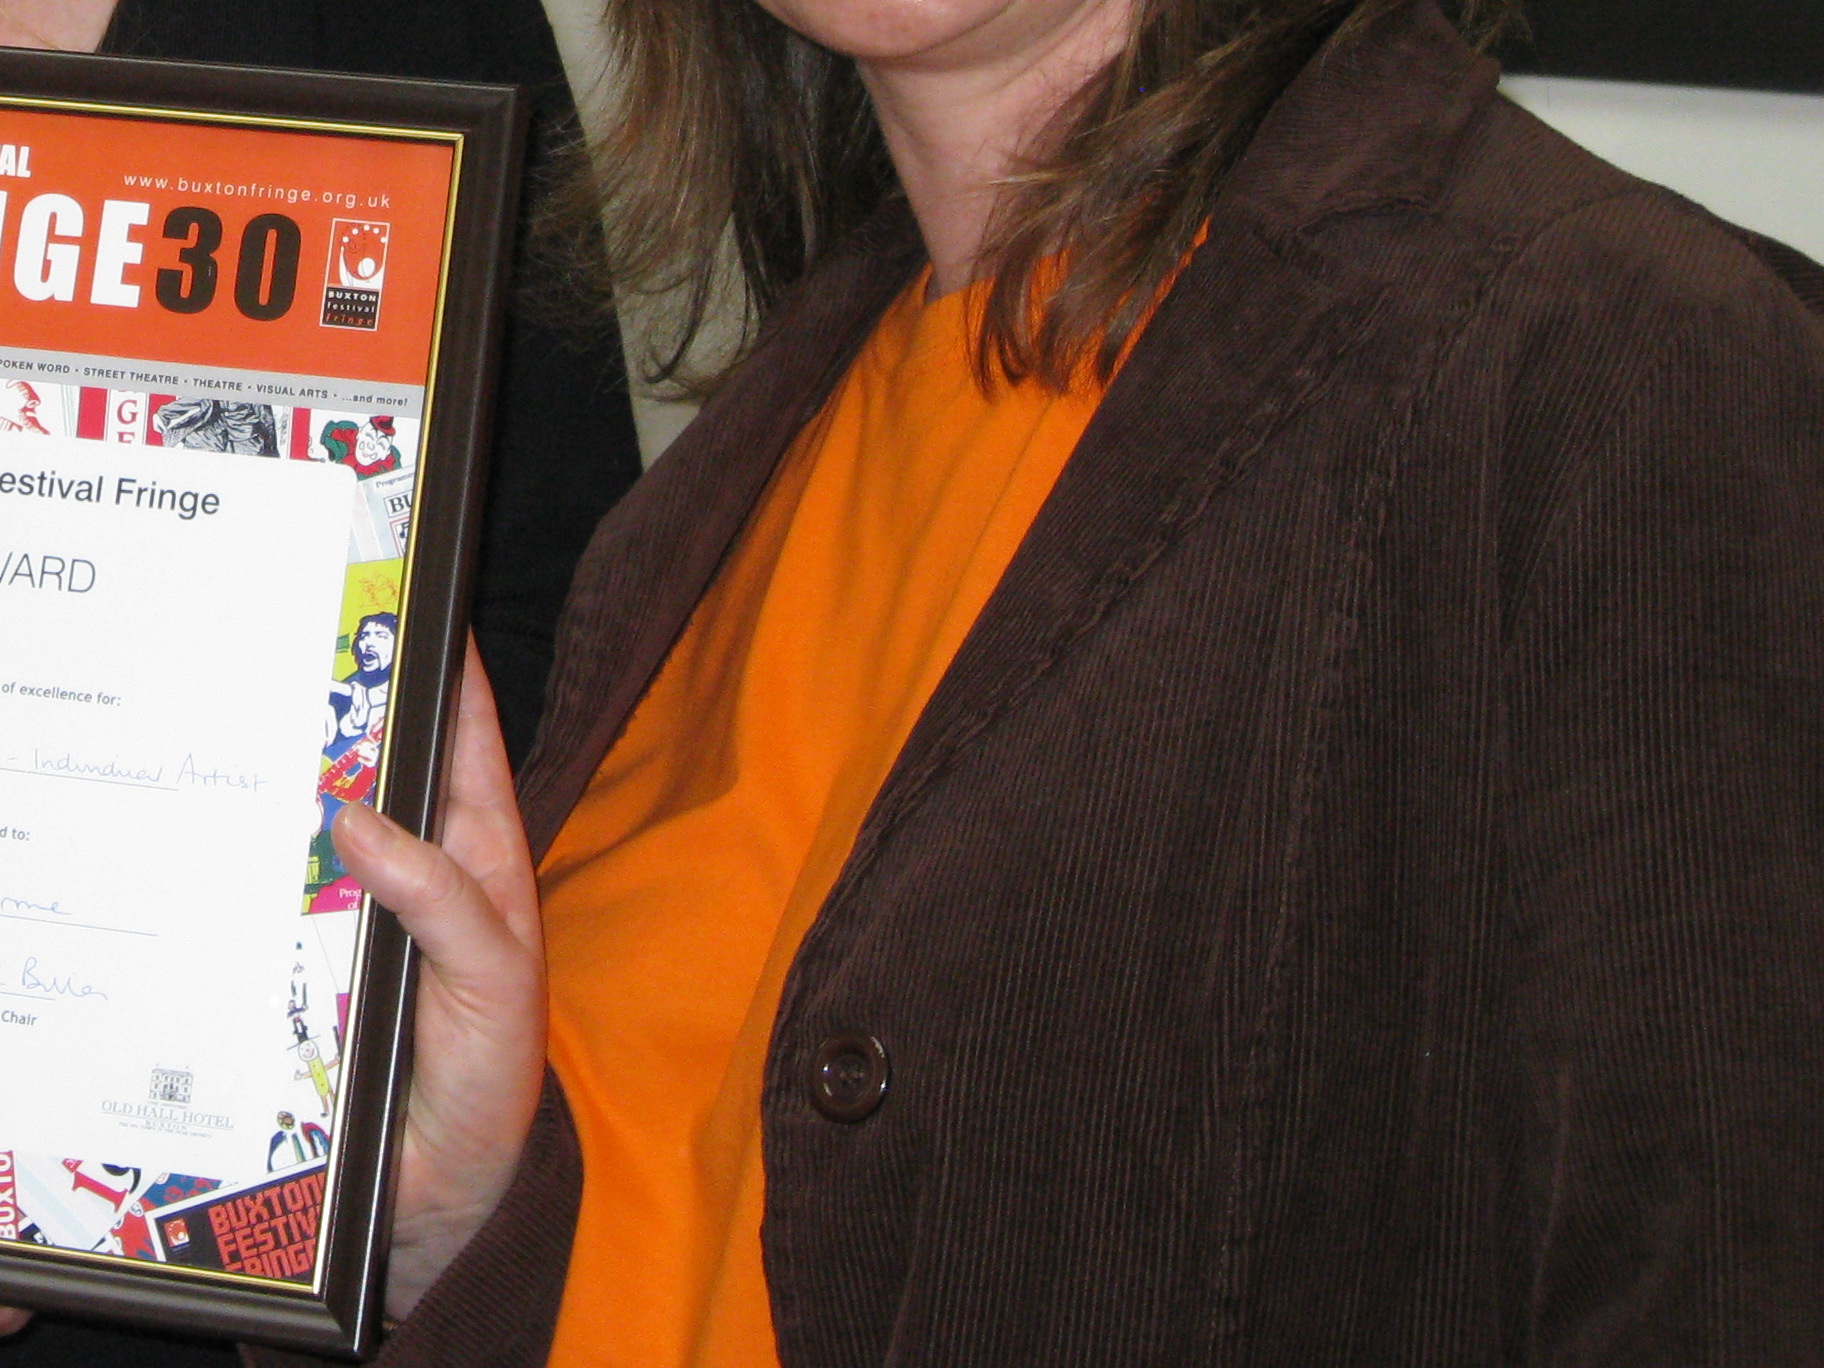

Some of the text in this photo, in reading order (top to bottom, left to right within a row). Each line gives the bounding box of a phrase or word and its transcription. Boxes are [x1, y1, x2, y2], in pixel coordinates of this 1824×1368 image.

[123, 175, 390, 208] www.buxtonfringe.org.uk
[328, 290, 376, 302] BUXTON
[37, 361, 71, 374] WORD
[83, 366, 126, 380] STREET
[130, 371, 179, 385] THEATRE
[193, 377, 242, 391] THEATRE
[256, 383, 296, 397] VISUAL
[298, 388, 328, 400] ARTS
[114, 477, 221, 520] Fringe
[2, 681, 16, 694] of
[19, 684, 93, 704] excellence
[96, 691, 122, 707] for:
[11, 827, 31, 842] to:
[0, 1010, 38, 1027] Chair
[101, 1099, 133, 1115] OLD
[136, 1104, 179, 1122] HALL
[182, 1111, 235, 1129] HOTEL
